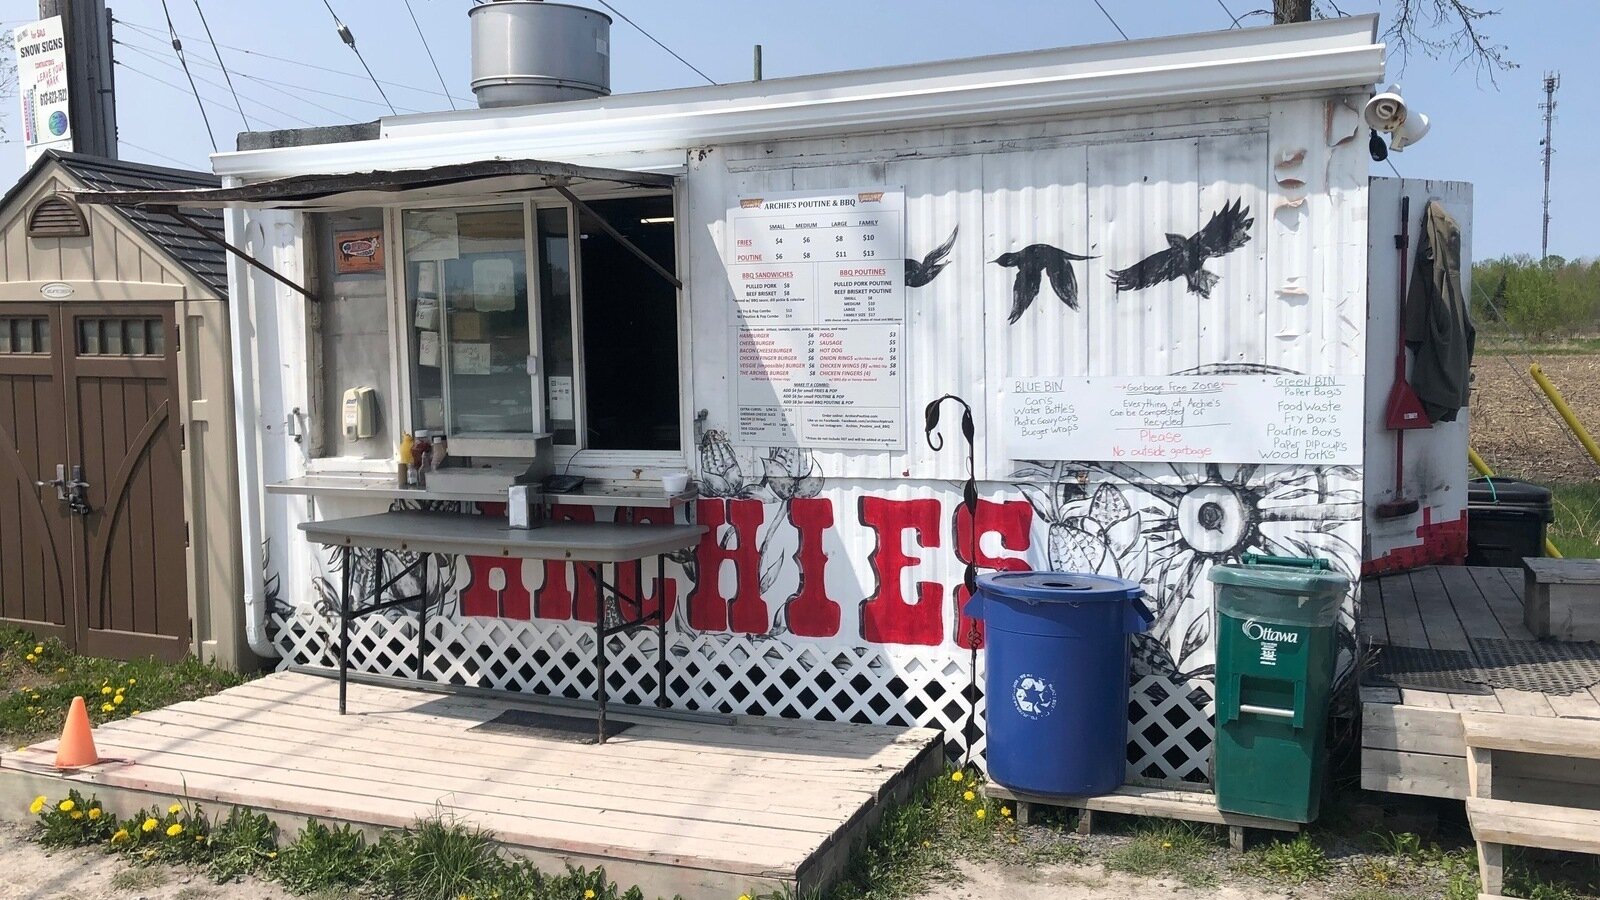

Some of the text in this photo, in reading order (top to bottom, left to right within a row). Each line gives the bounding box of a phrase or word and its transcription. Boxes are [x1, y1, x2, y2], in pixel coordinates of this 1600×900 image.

[20, 37, 63, 58] SNOW SIGNS
[36, 68, 52, 83] LEAVE
[764, 201, 797, 210] ARCHIE'S
[798, 200, 832, 209] POUTINE
[833, 199, 839, 207] &
[839, 198, 856, 208] BBQ
[737, 239, 753, 247] FRIES
[775, 237, 783, 245] $4
[802, 236, 811, 244] $6
[862, 234, 875, 242] $10
[1015, 379, 1063, 393] BLUE BIN
[1127, 382, 1221, 394] Garbage Free Zone
[1315, 376, 1336, 387] BIN
[1014, 406, 1040, 414] Water
[1123, 398, 1167, 410] Everything
[1172, 397, 1182, 407] at
[1278, 399, 1341, 412] Food Waste
[1126, 408, 1136, 417] be
[1285, 411, 1303, 424] Fry
[1014, 416, 1036, 426] Plastic
[1144, 415, 1184, 429] Recycled
[1021, 426, 1049, 440] Burger
[1140, 429, 1182, 443] Please
[1267, 423, 1308, 436] Poutine
[1112, 445, 1212, 460] No outside garbage
[1258, 448, 1299, 459] Wood
[1242, 618, 1298, 643] Ottawa
